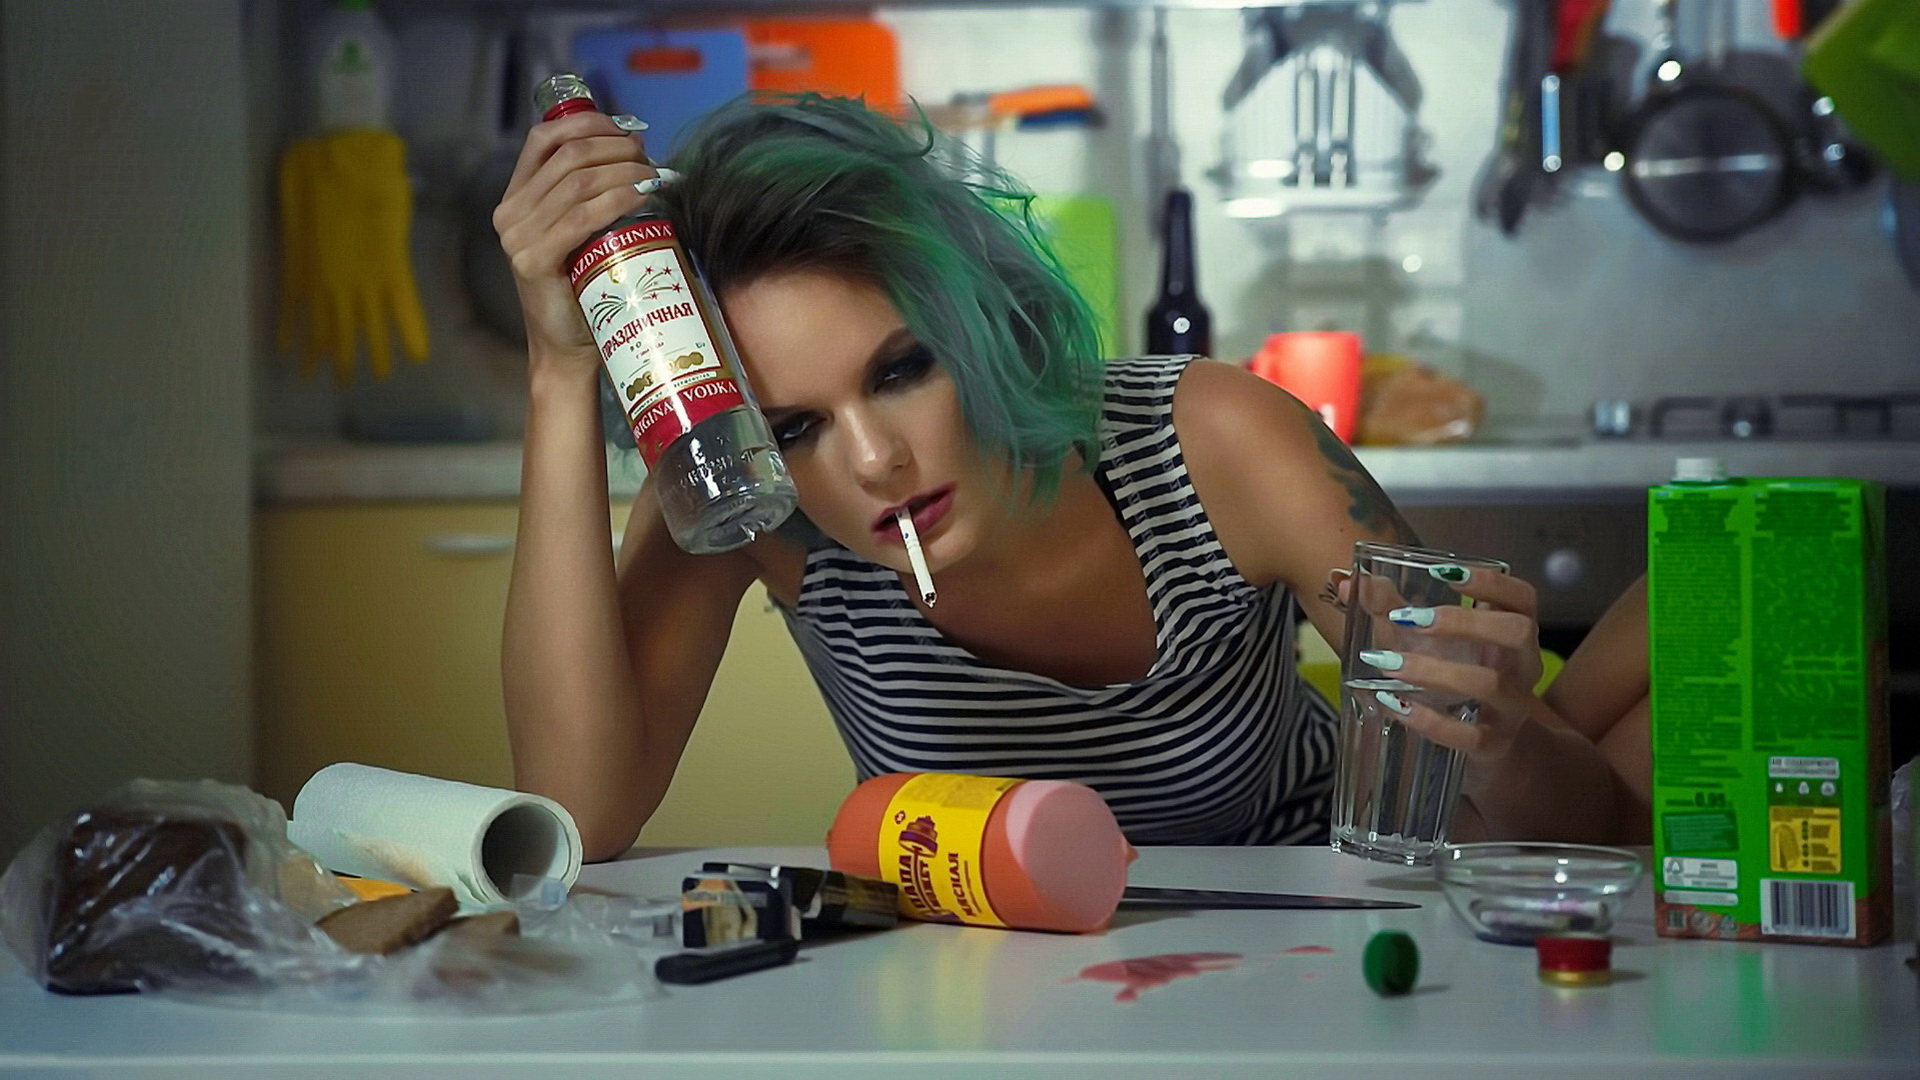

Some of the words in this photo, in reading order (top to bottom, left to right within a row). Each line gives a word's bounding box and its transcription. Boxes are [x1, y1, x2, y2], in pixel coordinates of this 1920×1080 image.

[601, 302, 694, 360] ПРАЗДНИЧНАЯ
[682, 381, 739, 402] VODKA
[898, 855, 926, 909] ПАПА
[947, 853, 977, 917] МЯСНАЯ
